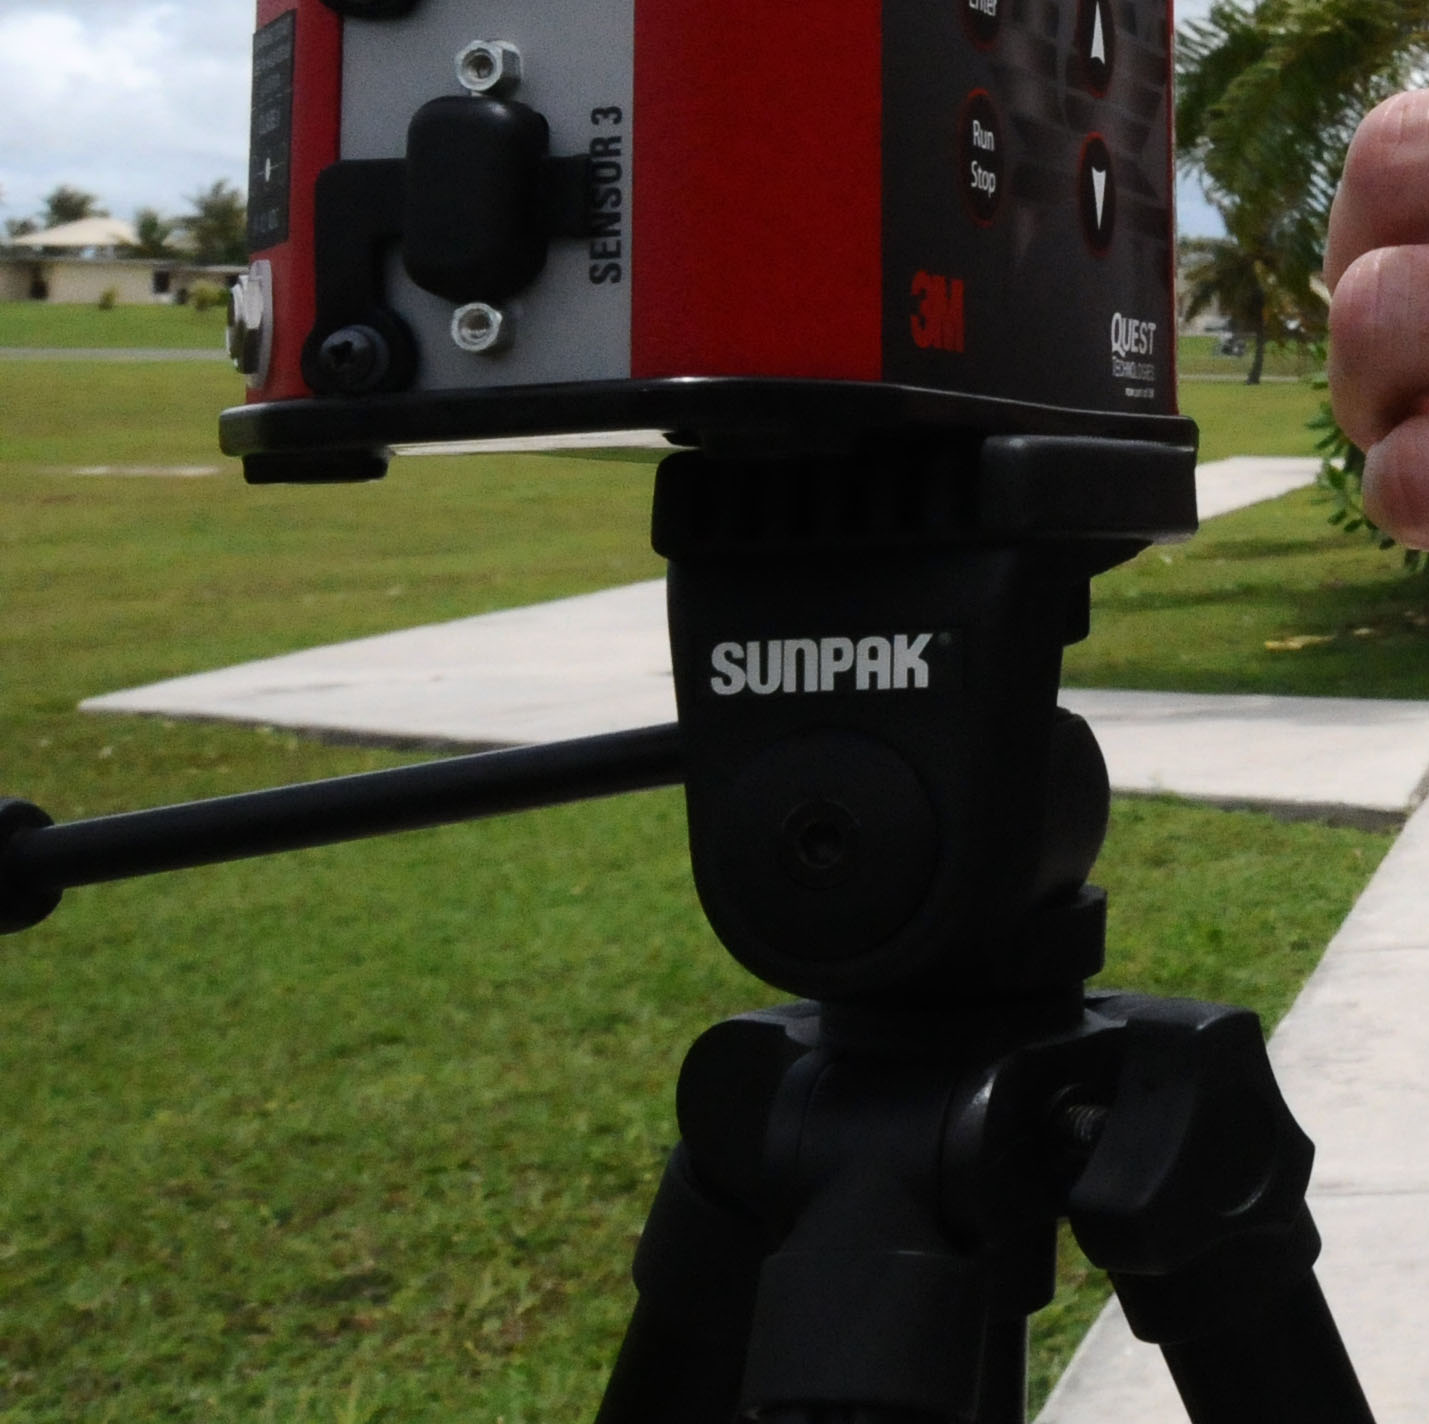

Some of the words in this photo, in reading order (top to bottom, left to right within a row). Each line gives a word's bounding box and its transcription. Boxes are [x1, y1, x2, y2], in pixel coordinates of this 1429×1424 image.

[590, 106, 623, 125] 3
[973, 120, 995, 151] Run
[970, 161, 996, 198] Stop
[589, 136, 623, 284] SENSOR
[911, 269, 965, 353] 3M
[1111, 312, 1157, 358] QUEST
[711, 633, 934, 696] SUNPAK
